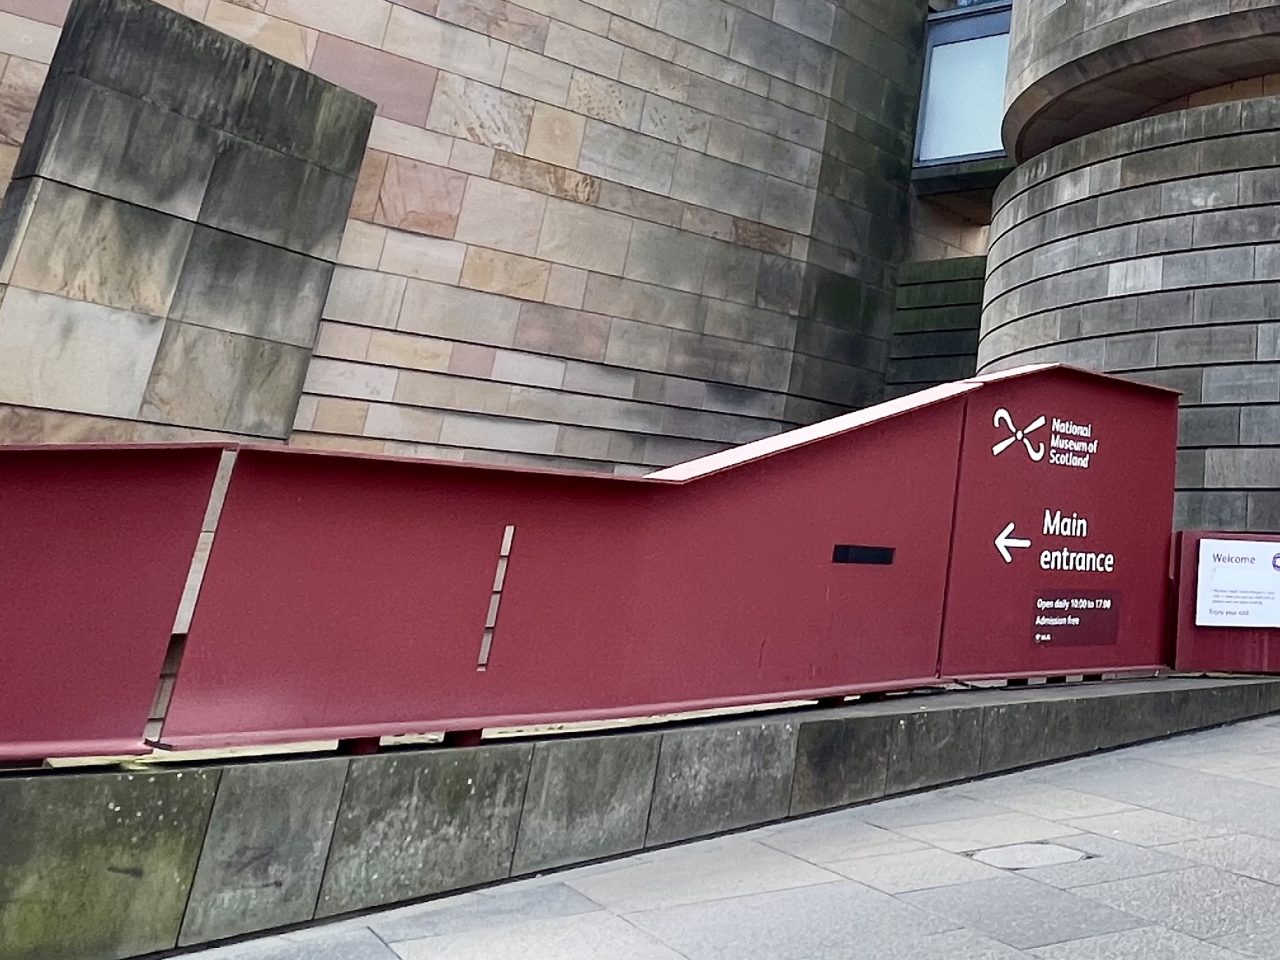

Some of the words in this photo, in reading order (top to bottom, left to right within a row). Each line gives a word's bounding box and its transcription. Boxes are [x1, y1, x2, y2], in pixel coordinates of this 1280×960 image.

[1051, 418, 1092, 437] National
[1050, 434, 1088, 452] Museum
[1088, 440, 1098, 454] of
[1049, 449, 1090, 468] Scotland
[1043, 509, 1087, 537] Main
[1040, 547, 1114, 572] entrance
[1212, 553, 1256, 564] Welcome
[1036, 598, 1054, 610] Open
[1054, 598, 1070, 610] daily
[1087, 600, 1095, 609] to
[1035, 615, 1067, 625] Admission
[1067, 615, 1080, 625] free
